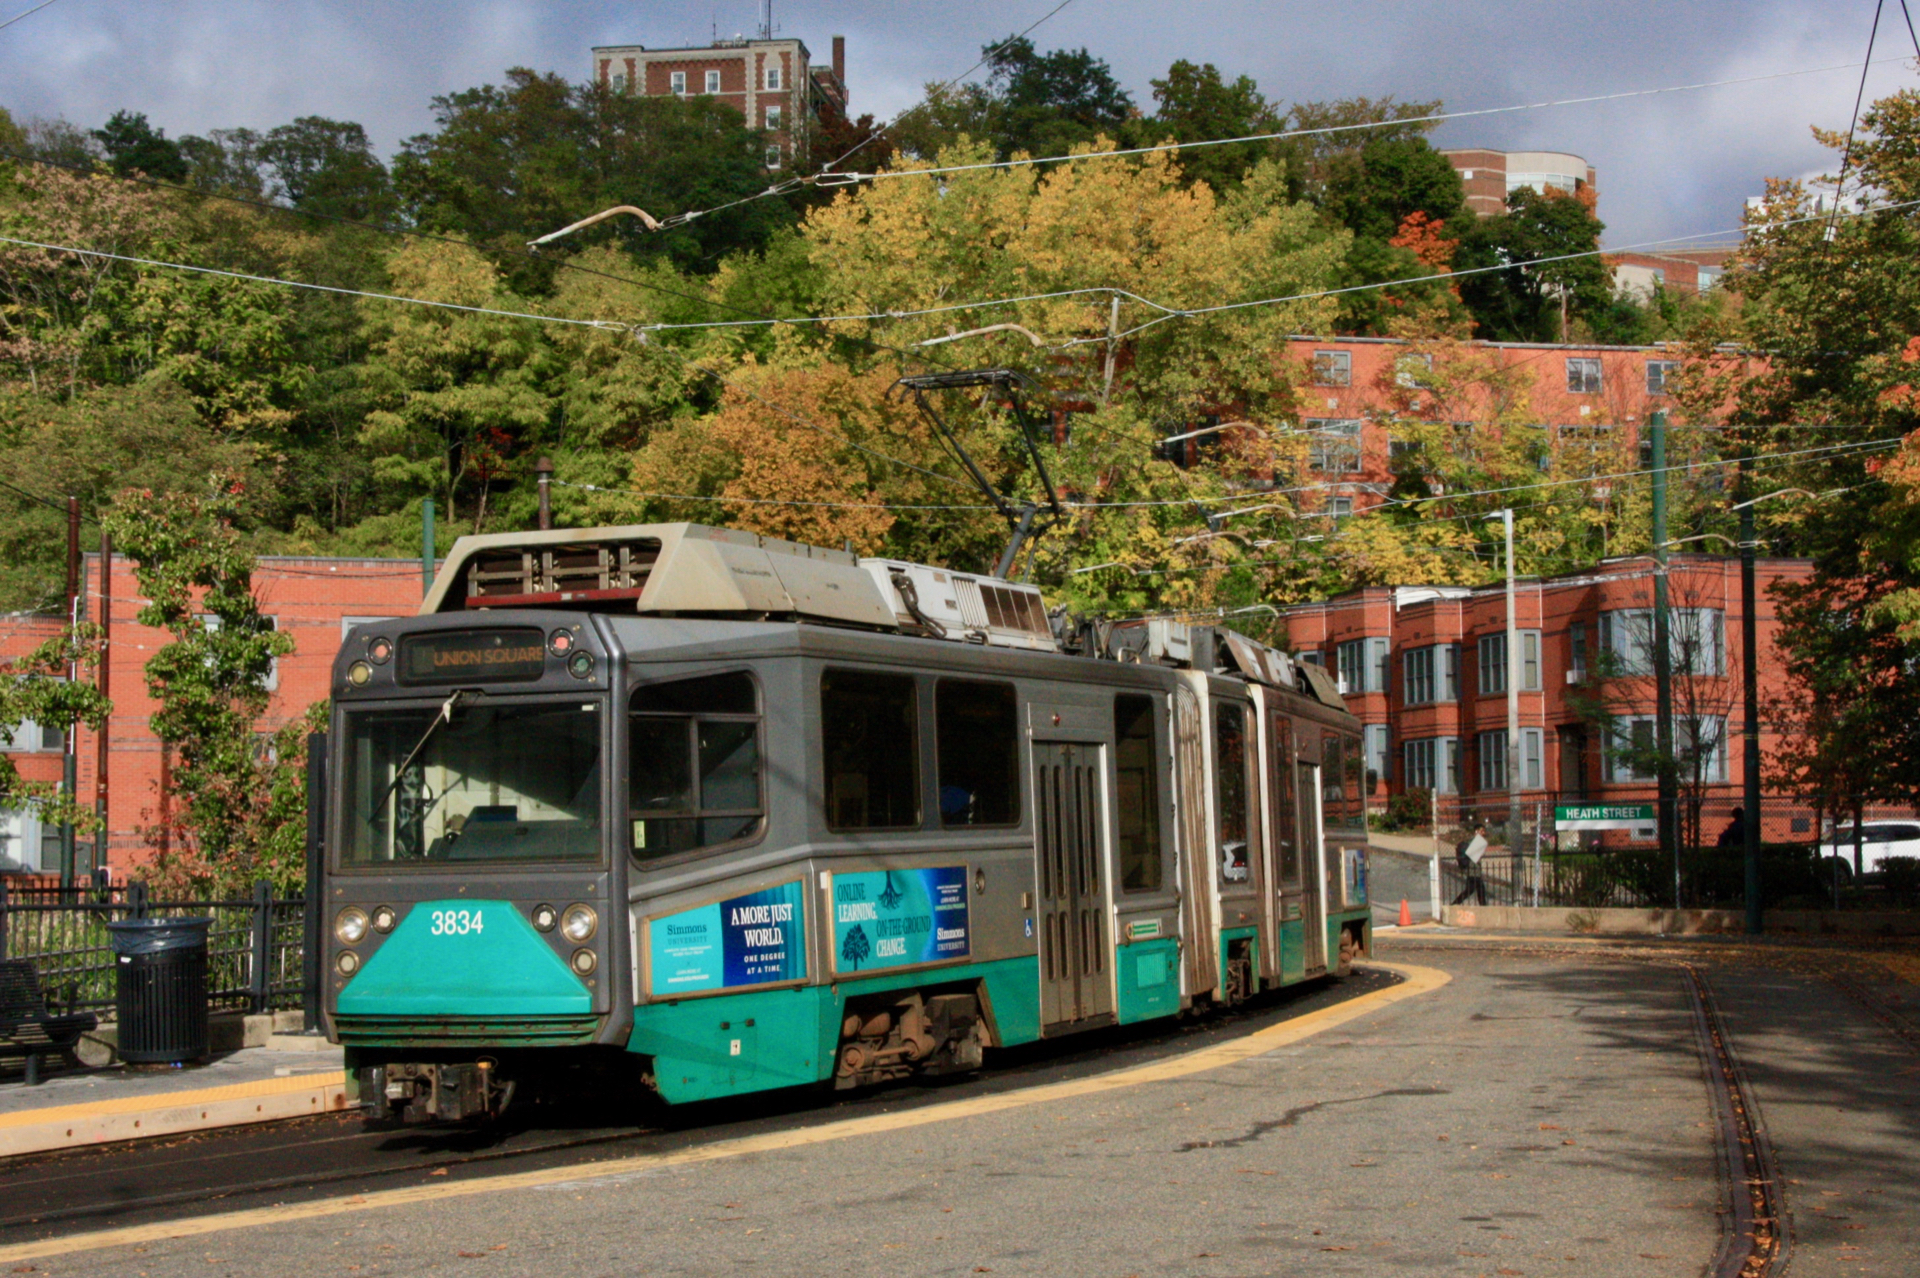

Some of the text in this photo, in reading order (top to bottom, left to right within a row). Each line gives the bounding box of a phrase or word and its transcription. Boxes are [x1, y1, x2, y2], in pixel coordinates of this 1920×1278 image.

[434, 647, 543, 666] UNION SQUARE
[1566, 807, 1642, 819] HEATH STREET
[837, 883, 866, 901] ONLINE
[731, 903, 793, 927] A MORE JUST
[838, 902, 878, 922] LEARNING.
[431, 910, 484, 935] 3834
[667, 924, 707, 935] Simmons
[876, 915, 931, 937] ON-THE-GROUND
[668, 935, 708, 945] UNIVERSITY
[744, 927, 784, 948] WORLD.
[937, 927, 965, 941] Simmons
[876, 937, 907, 957] CHANGE.
[937, 940, 965, 951] UNIVERSITY
[744, 952, 786, 963] ONE DEGREE
[764, 964, 783, 973] TIME.
